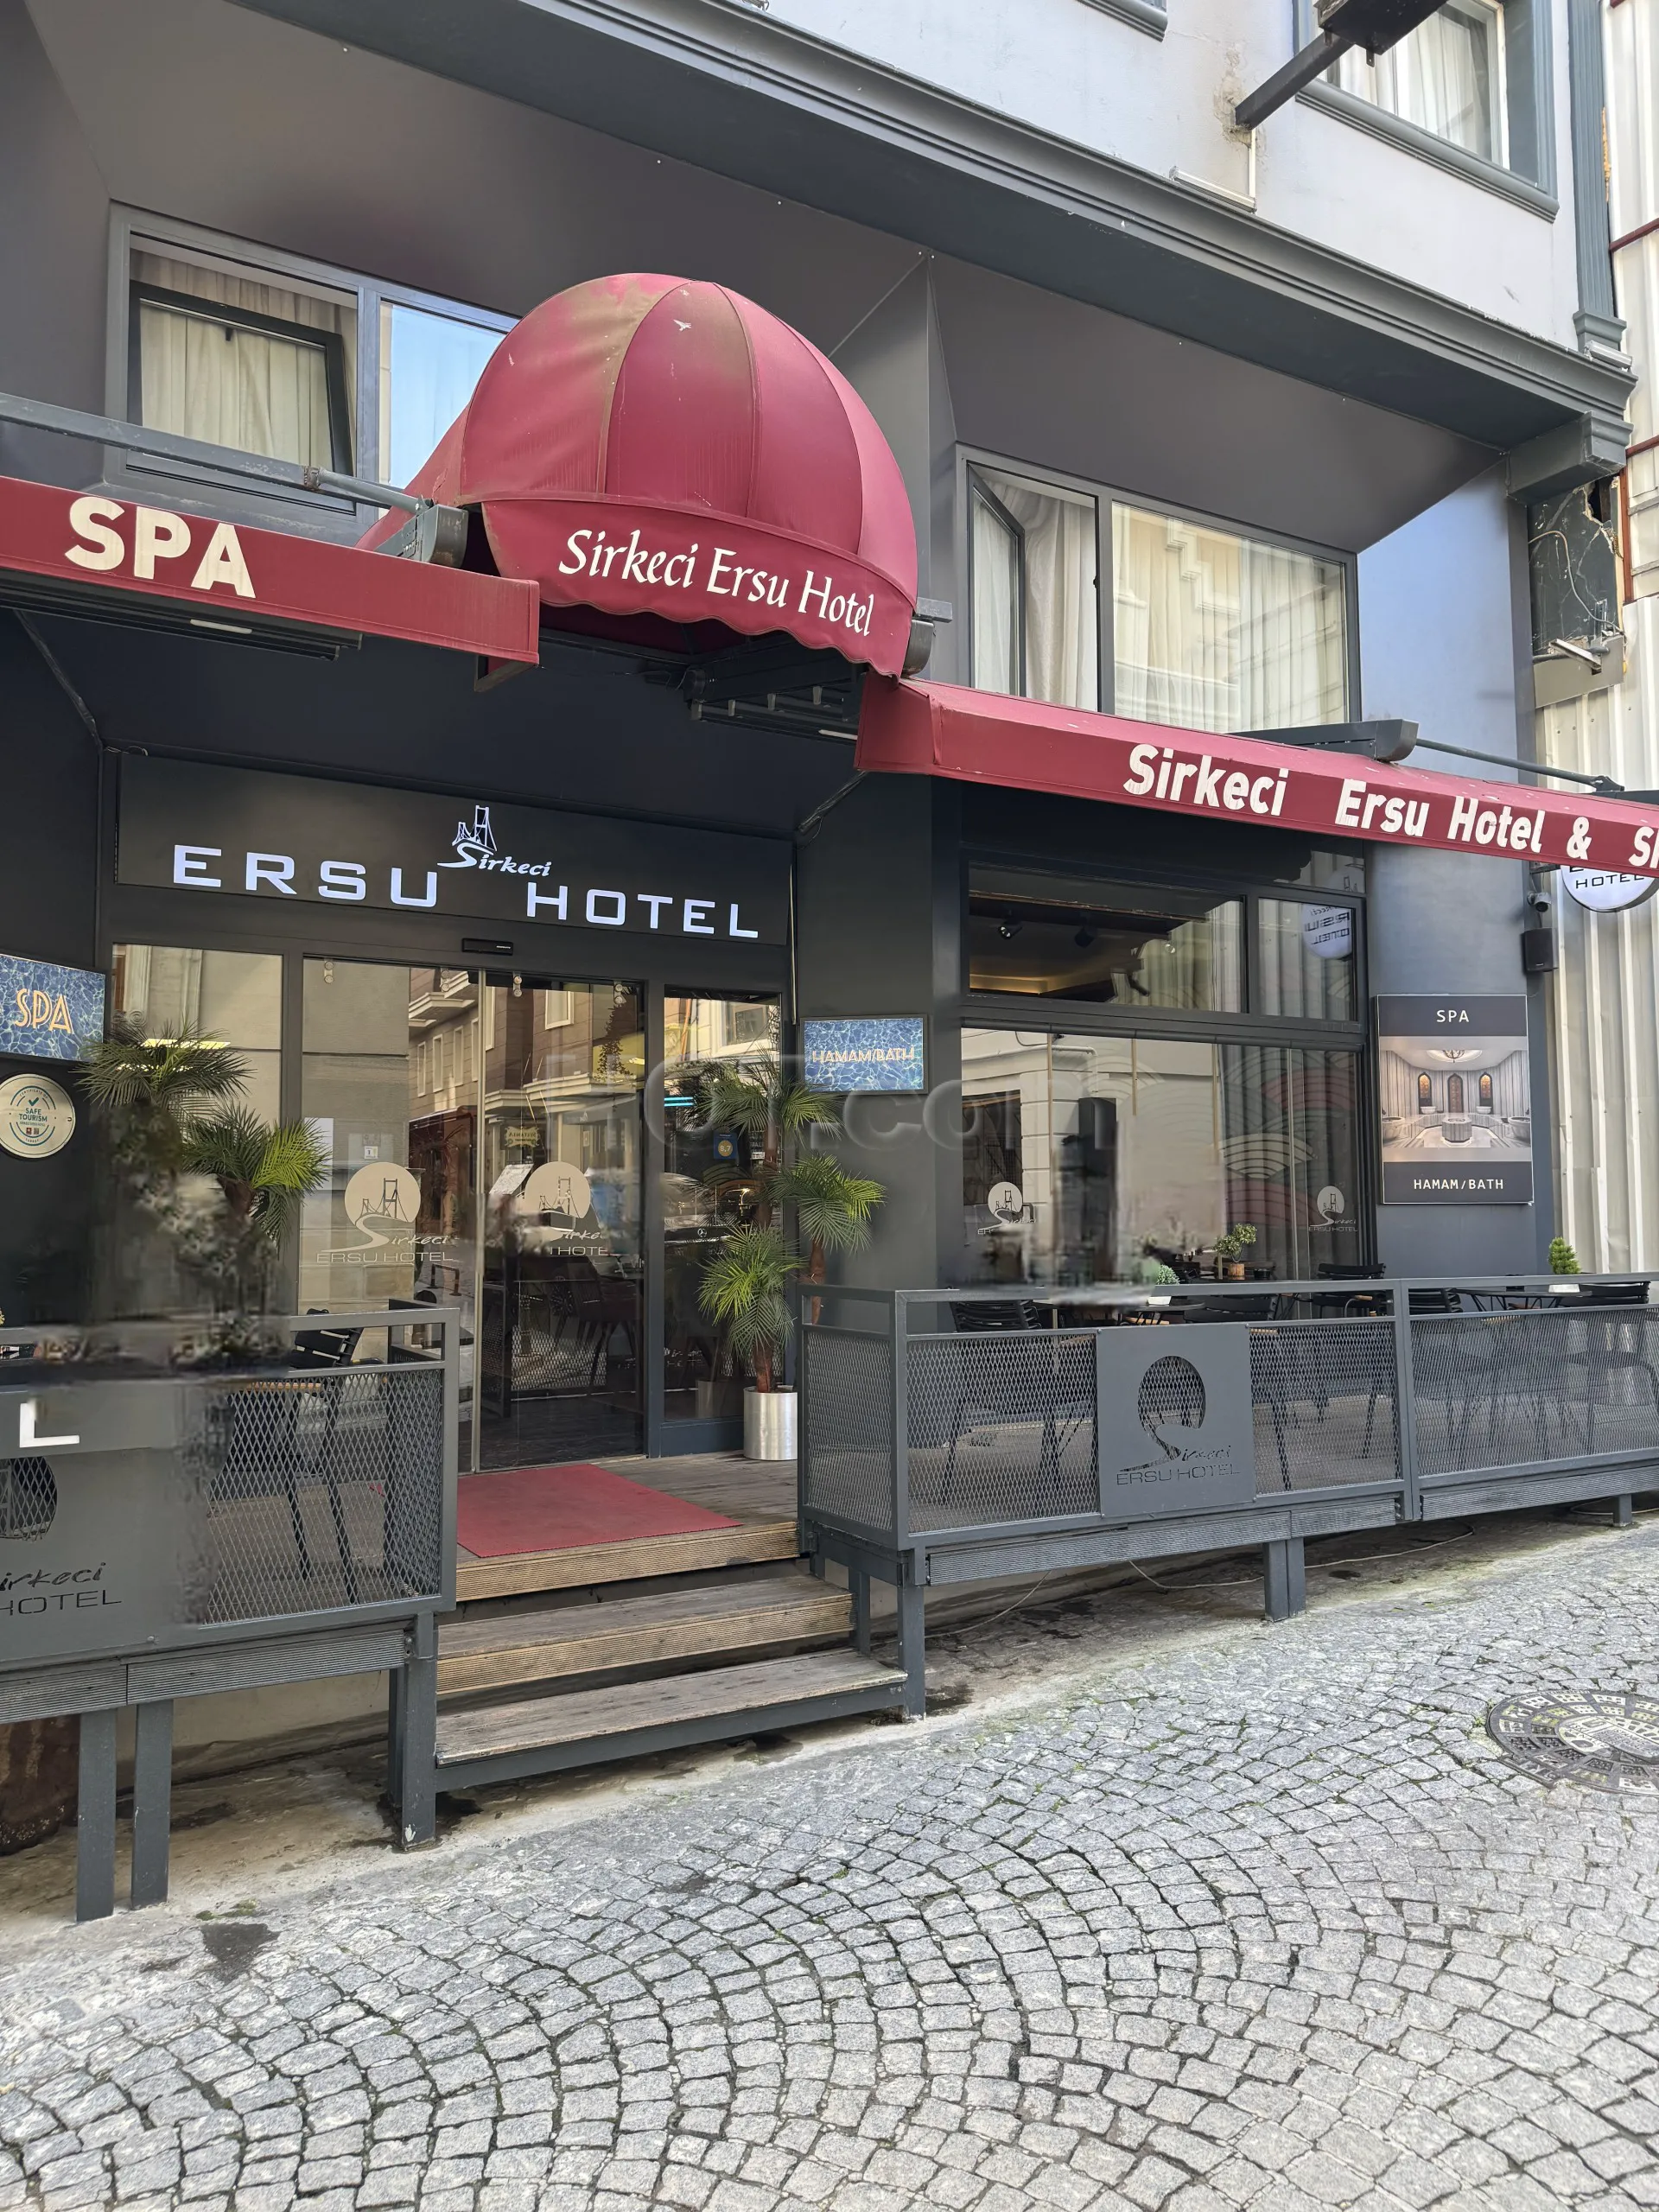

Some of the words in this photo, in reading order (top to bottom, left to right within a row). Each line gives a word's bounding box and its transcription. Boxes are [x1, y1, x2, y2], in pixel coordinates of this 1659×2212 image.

[64, 497, 256, 599] SPA
[558, 529, 698, 588] Sirkeci
[706, 547, 790, 607] Ersu
[798, 569, 874, 637] Hotel
[1122, 743, 1289, 817] Sirkeci
[1334, 779, 1430, 837] Ersu
[1447, 795, 1546, 854] Hotel
[1567, 817, 1592, 860] &
[1628, 826, 1659, 869] S
[437, 842, 552, 877] Sirkeci
[173, 844, 438, 907] ERSU
[526, 881, 759, 938] HOTEL
[14, 988, 73, 1033] SPA
[1436, 1009, 1469, 1022] SPA
[812, 1045, 915, 1064] HAMAM/BATH
[19, 1113, 48, 1122] TOURISM
[1414, 1179, 1503, 1190] HAMAM/BATH
[316, 1253, 377, 1262] ERSU
[384, 1252, 454, 1262] HOTEL
[557, 1246, 610, 1256] HOTE
[1116, 1469, 1172, 1485] ERSU
[1177, 1464, 1241, 1481] HOTEL
[0, 1561, 106, 1591] irkeci
